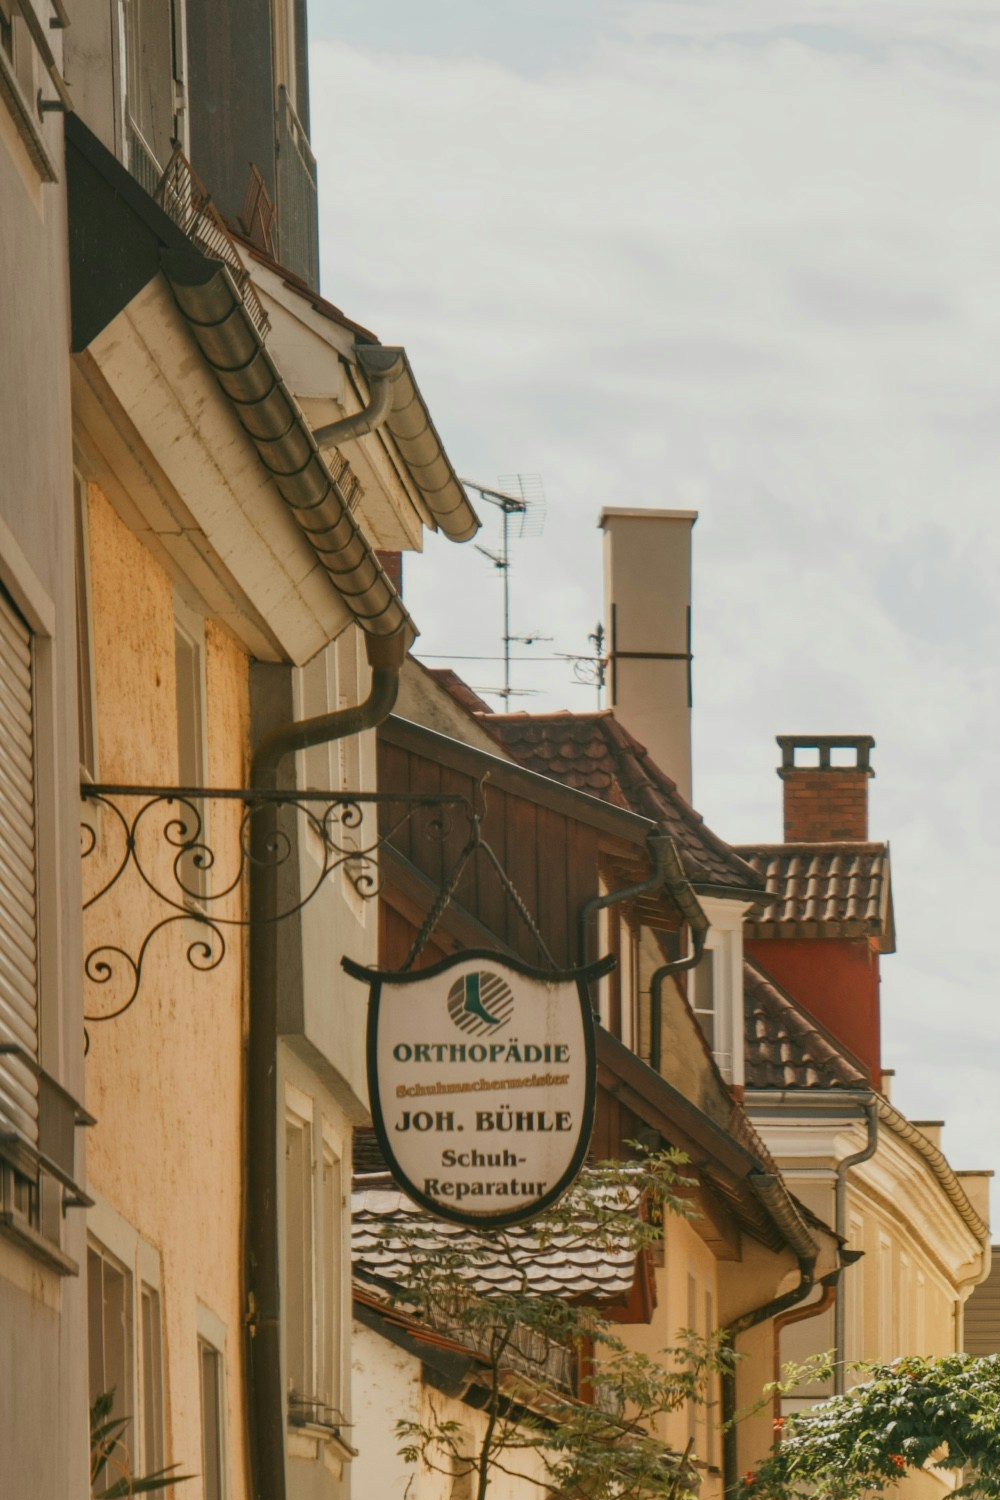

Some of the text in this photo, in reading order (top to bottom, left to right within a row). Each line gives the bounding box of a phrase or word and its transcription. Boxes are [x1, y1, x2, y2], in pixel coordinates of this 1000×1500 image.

[393, 1038, 571, 1063] ORTHOPÄDIE
[395, 1072, 570, 1099] Schuhmachermeister
[394, 1104, 573, 1132] JOH. BÜHLE
[441, 1150, 527, 1167] Schuh-
[424, 1178, 547, 1200] Reparatur
